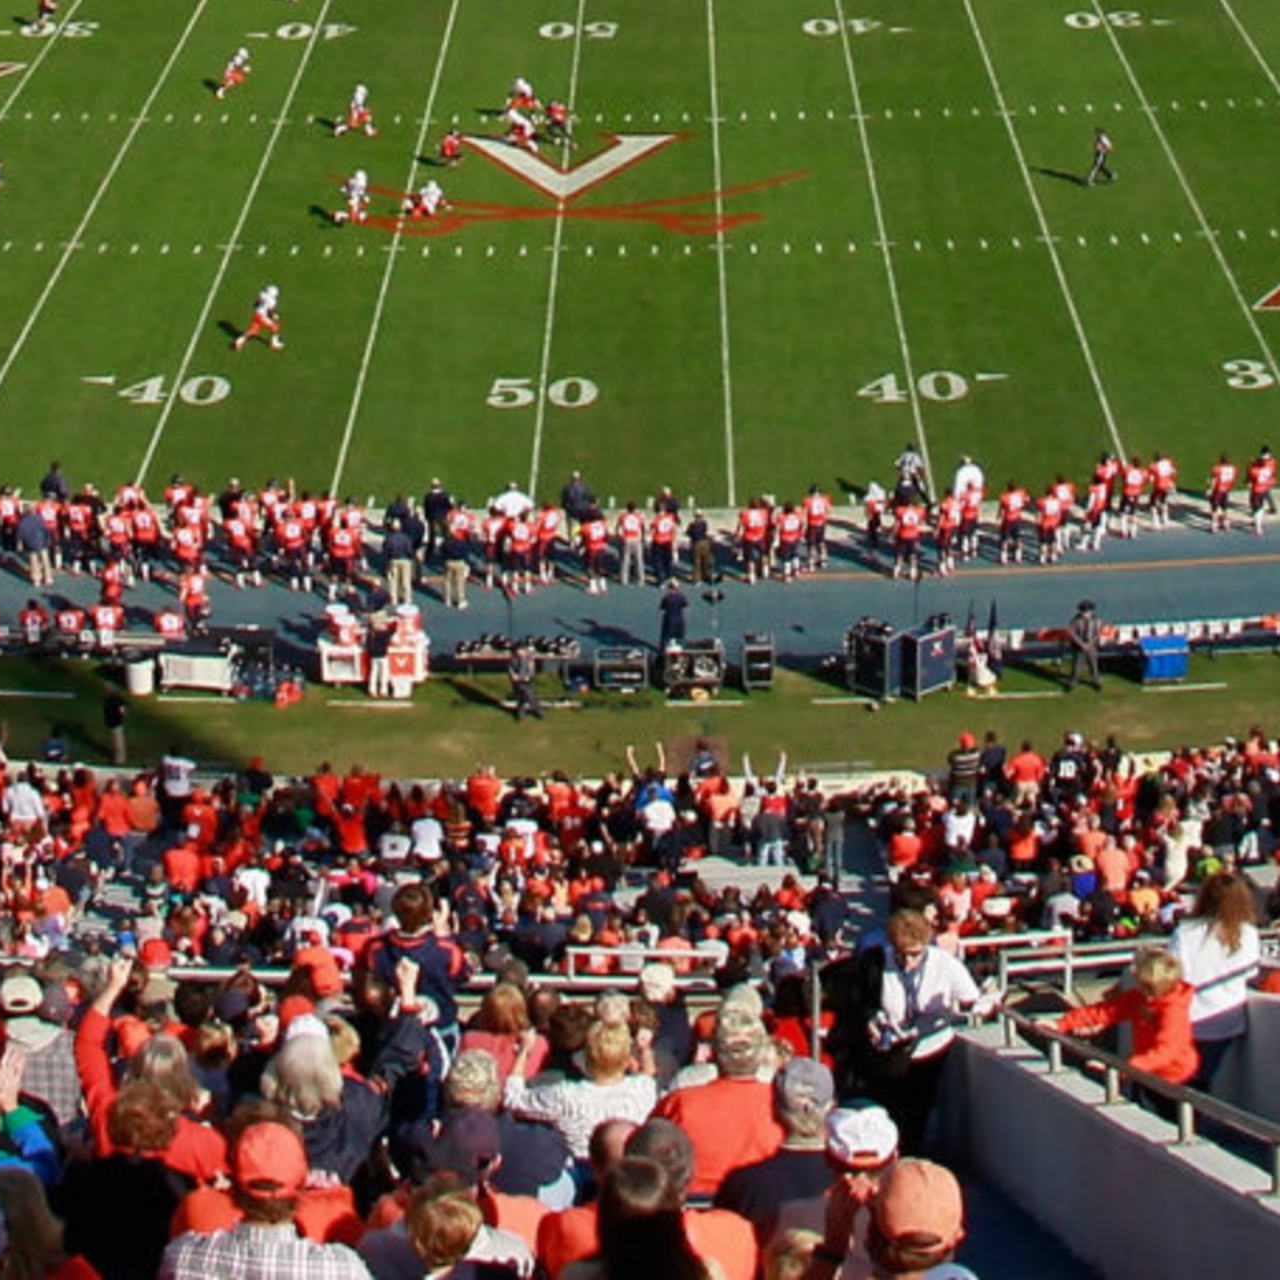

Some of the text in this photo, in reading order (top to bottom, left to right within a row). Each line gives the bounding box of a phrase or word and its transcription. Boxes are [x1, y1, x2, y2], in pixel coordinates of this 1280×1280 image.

[539, 21, 619, 40] 50
[802, 18, 882, 37] 40
[1065, 12, 1142, 28] 30
[274, 21, 359, 42] 40
[117, 375, 231, 405] 40
[487, 377, 598, 409] 50
[856, 370, 969, 403] 40
